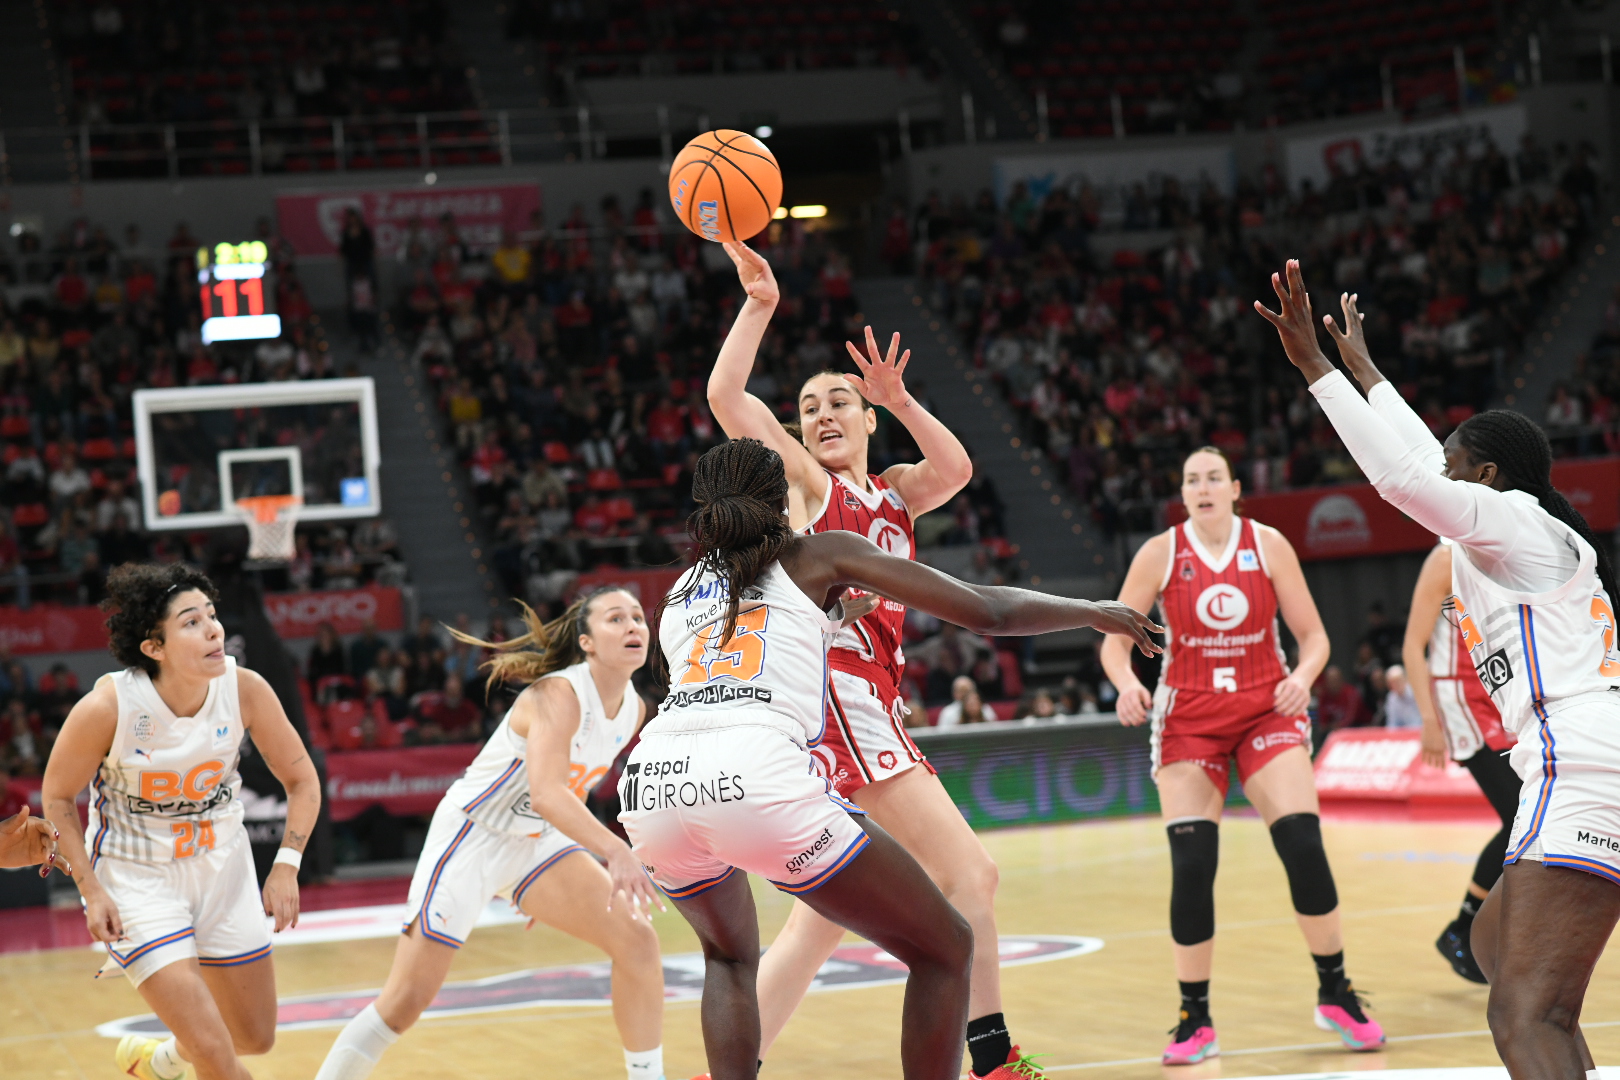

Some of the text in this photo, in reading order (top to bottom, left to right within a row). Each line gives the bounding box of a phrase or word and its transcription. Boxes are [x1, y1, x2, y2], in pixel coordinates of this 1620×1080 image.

[213, 278, 264, 317] 11
[675, 604, 769, 687] 15
[1212, 666, 1238, 693] 5
[140, 760, 225, 801] BG
[643, 756, 691, 780] espai
[641, 771, 745, 811] GIRONÈS
[171, 820, 216, 860] 24
[785, 827, 834, 876] ginvest
